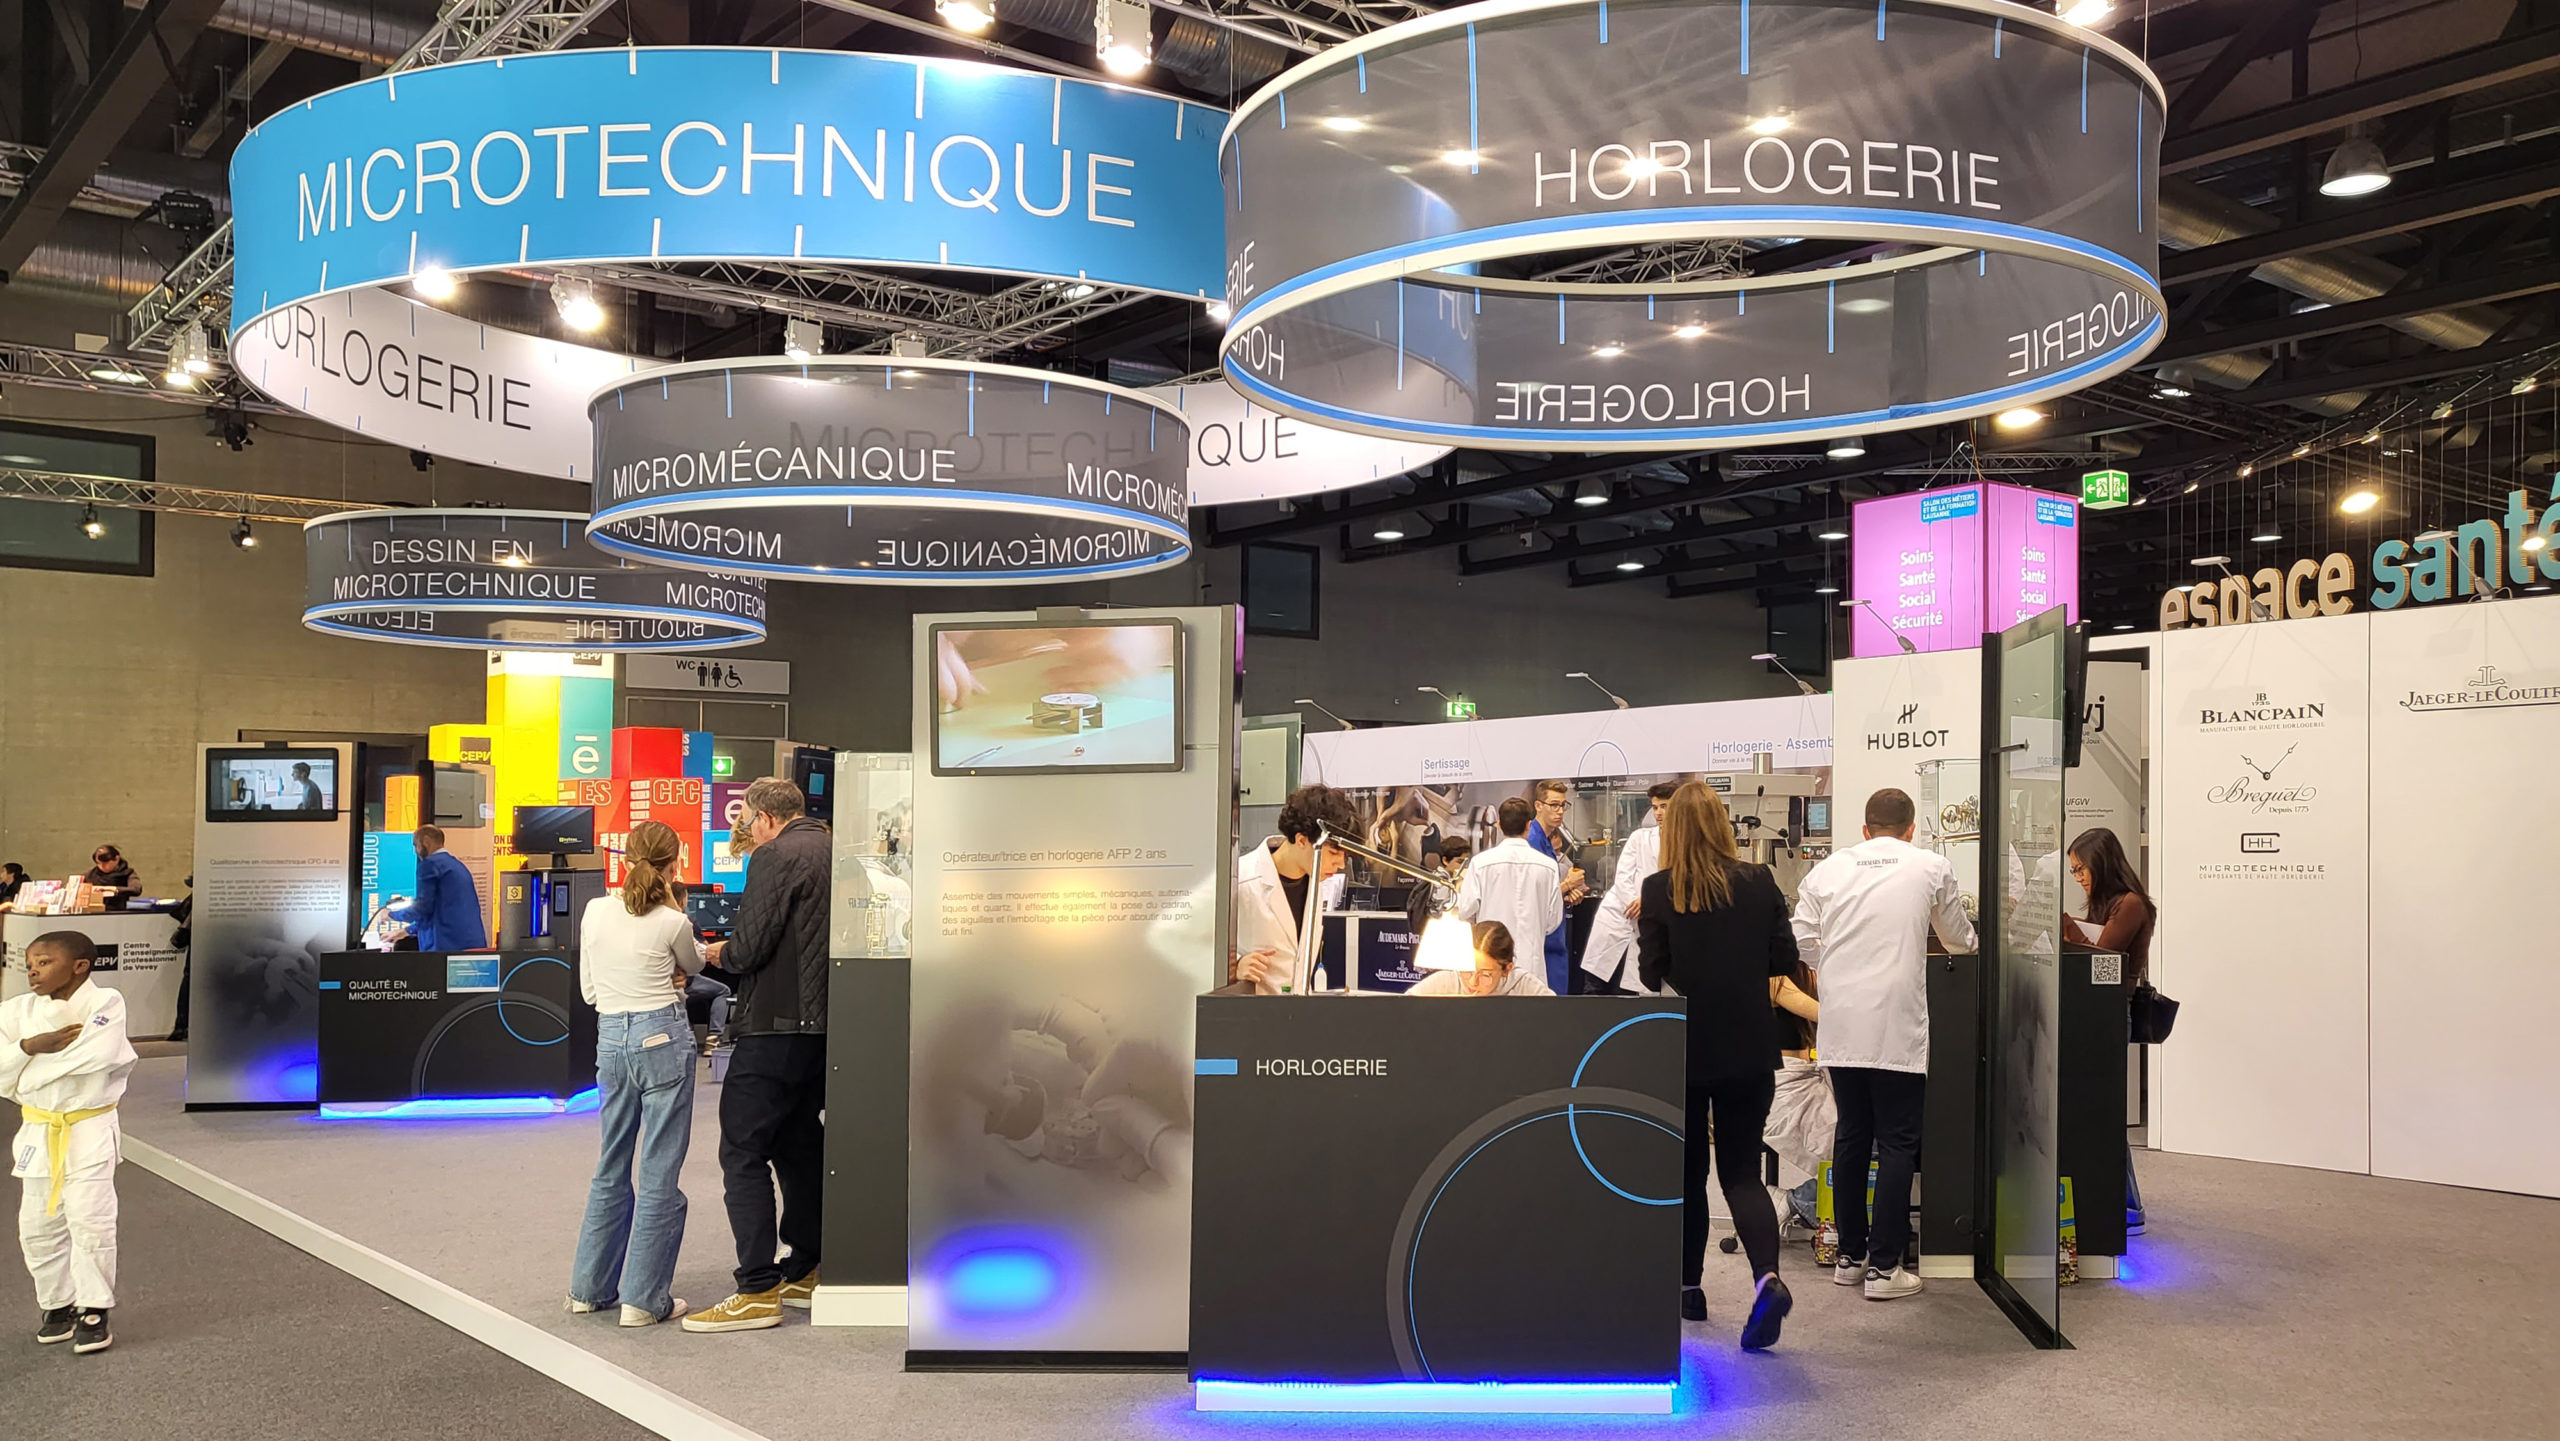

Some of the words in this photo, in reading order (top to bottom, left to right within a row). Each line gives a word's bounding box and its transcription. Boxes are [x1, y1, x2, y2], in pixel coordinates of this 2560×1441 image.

[298, 121, 1135, 241] MICROTECHNIQUE
[1535, 136, 2001, 210] HORLOGERIE
[613, 441, 956, 500] MICROMÉCANIQUE
[1923, 499, 1940, 507] SALON
[372, 538, 476, 564] DESSIN
[491, 540, 533, 564] EN
[1901, 548, 1934, 566] Soins
[2022, 546, 2045, 563] Soins
[1899, 569, 1935, 586] Santé
[2021, 566, 2046, 584] Santé
[333, 572, 596, 601] MICROTECHNIQUE
[1899, 590, 1935, 607] Social
[2021, 588, 2046, 605] Social
[1892, 610, 1943, 629] Sécurité
[676, 660, 695, 670] WC
[2200, 703, 2325, 724] BLANCPAIN
[1713, 740, 1773, 754] Horlogerie
[1868, 729, 1949, 750] HUBLOT
[460, 751, 491, 761] CEPV
[1424, 759, 1470, 770] Sertissage
[579, 781, 612, 805] ES
[653, 779, 701, 805] CFC
[2207, 776, 2317, 814] Breguet
[1048, 850, 1104, 862] horlogerie
[1107, 849, 1131, 859] AFP
[1135, 848, 1142, 859] 2
[1146, 850, 1167, 859] ans
[2200, 864, 2325, 873] MICROTECHNIQUE
[942, 892, 984, 900] Assemble
[987, 892, 1002, 900] des
[1063, 891, 1097, 899] simples,
[1101, 890, 1154, 898] mécaniques,
[942, 905, 968, 913] tiques
[1063, 902, 1106, 911] également
[1146, 901, 1157, 909] du
[1161, 901, 1192, 909] cadran,
[942, 916, 958, 924] des
[961, 916, 994, 925] aiguilles
[1082, 914, 1104, 923] pièce
[1175, 913, 1192, 922] pro-
[942, 928, 957, 936] duit
[961, 928, 973, 936] fini.
[1378, 931, 1407, 943] AUDEMARS
[94, 956, 118, 967] EPV
[123, 956, 177, 964] professionnel
[134, 964, 158, 972] Vevey
[349, 979, 390, 990] QUALITÉ
[393, 981, 407, 989] EN
[348, 991, 439, 1001] MICROTECHNIQUE
[1256, 1059, 1388, 1076] HORLOGERIE
